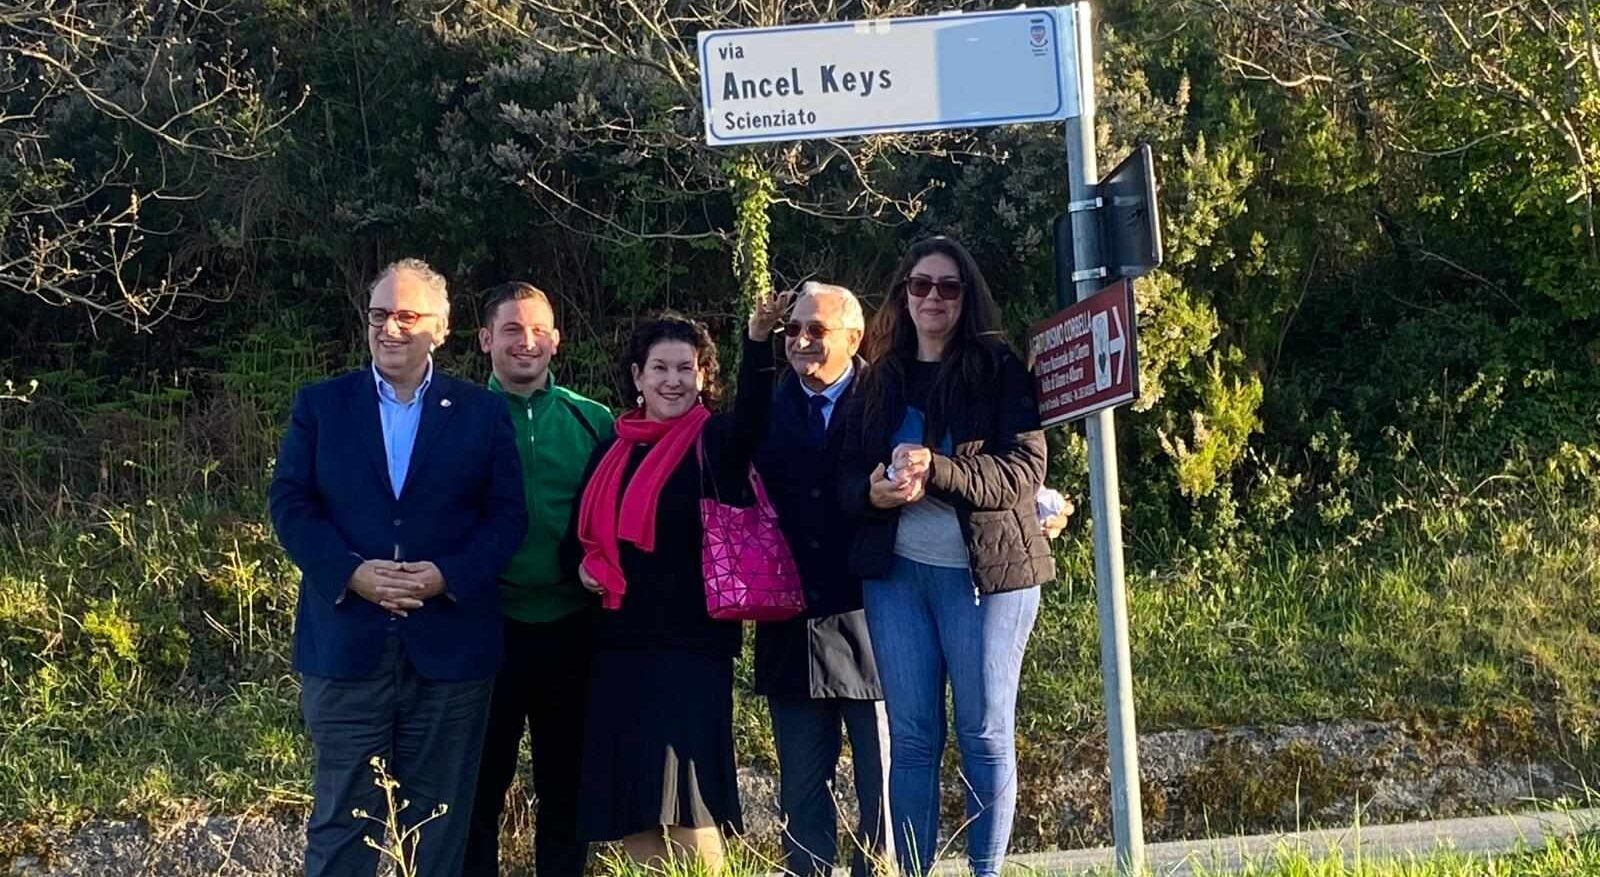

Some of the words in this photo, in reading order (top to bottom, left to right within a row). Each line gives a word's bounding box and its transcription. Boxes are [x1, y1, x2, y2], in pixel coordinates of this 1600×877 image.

[718, 42, 745, 61] via
[722, 67, 804, 101] Ancel
[820, 64, 893, 98] Keys
[724, 109, 817, 131] Scienziato
